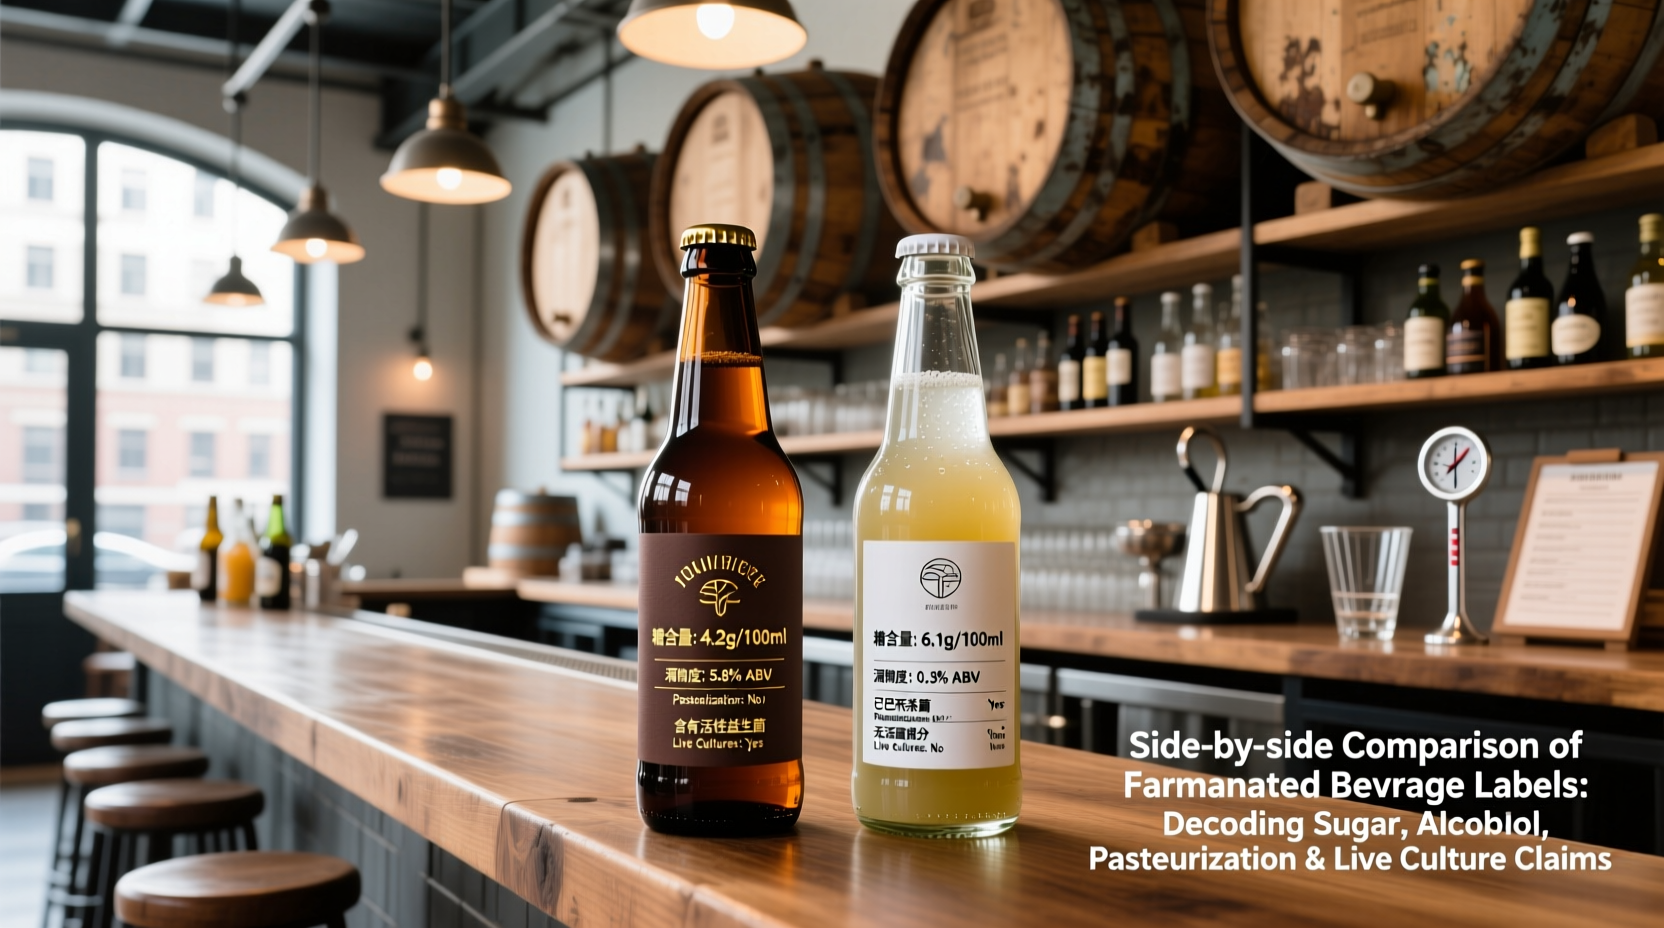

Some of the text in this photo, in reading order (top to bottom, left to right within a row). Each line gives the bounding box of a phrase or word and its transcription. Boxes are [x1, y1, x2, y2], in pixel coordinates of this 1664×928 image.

[700, 627, 787, 650] 4.2g/100ml
[921, 630, 1003, 651] 6.1g/100ml
[709, 668, 742, 683] 5.8%
[746, 668, 773, 682] ABV
[952, 670, 980, 684] ABV
[931, 742, 944, 753] No
